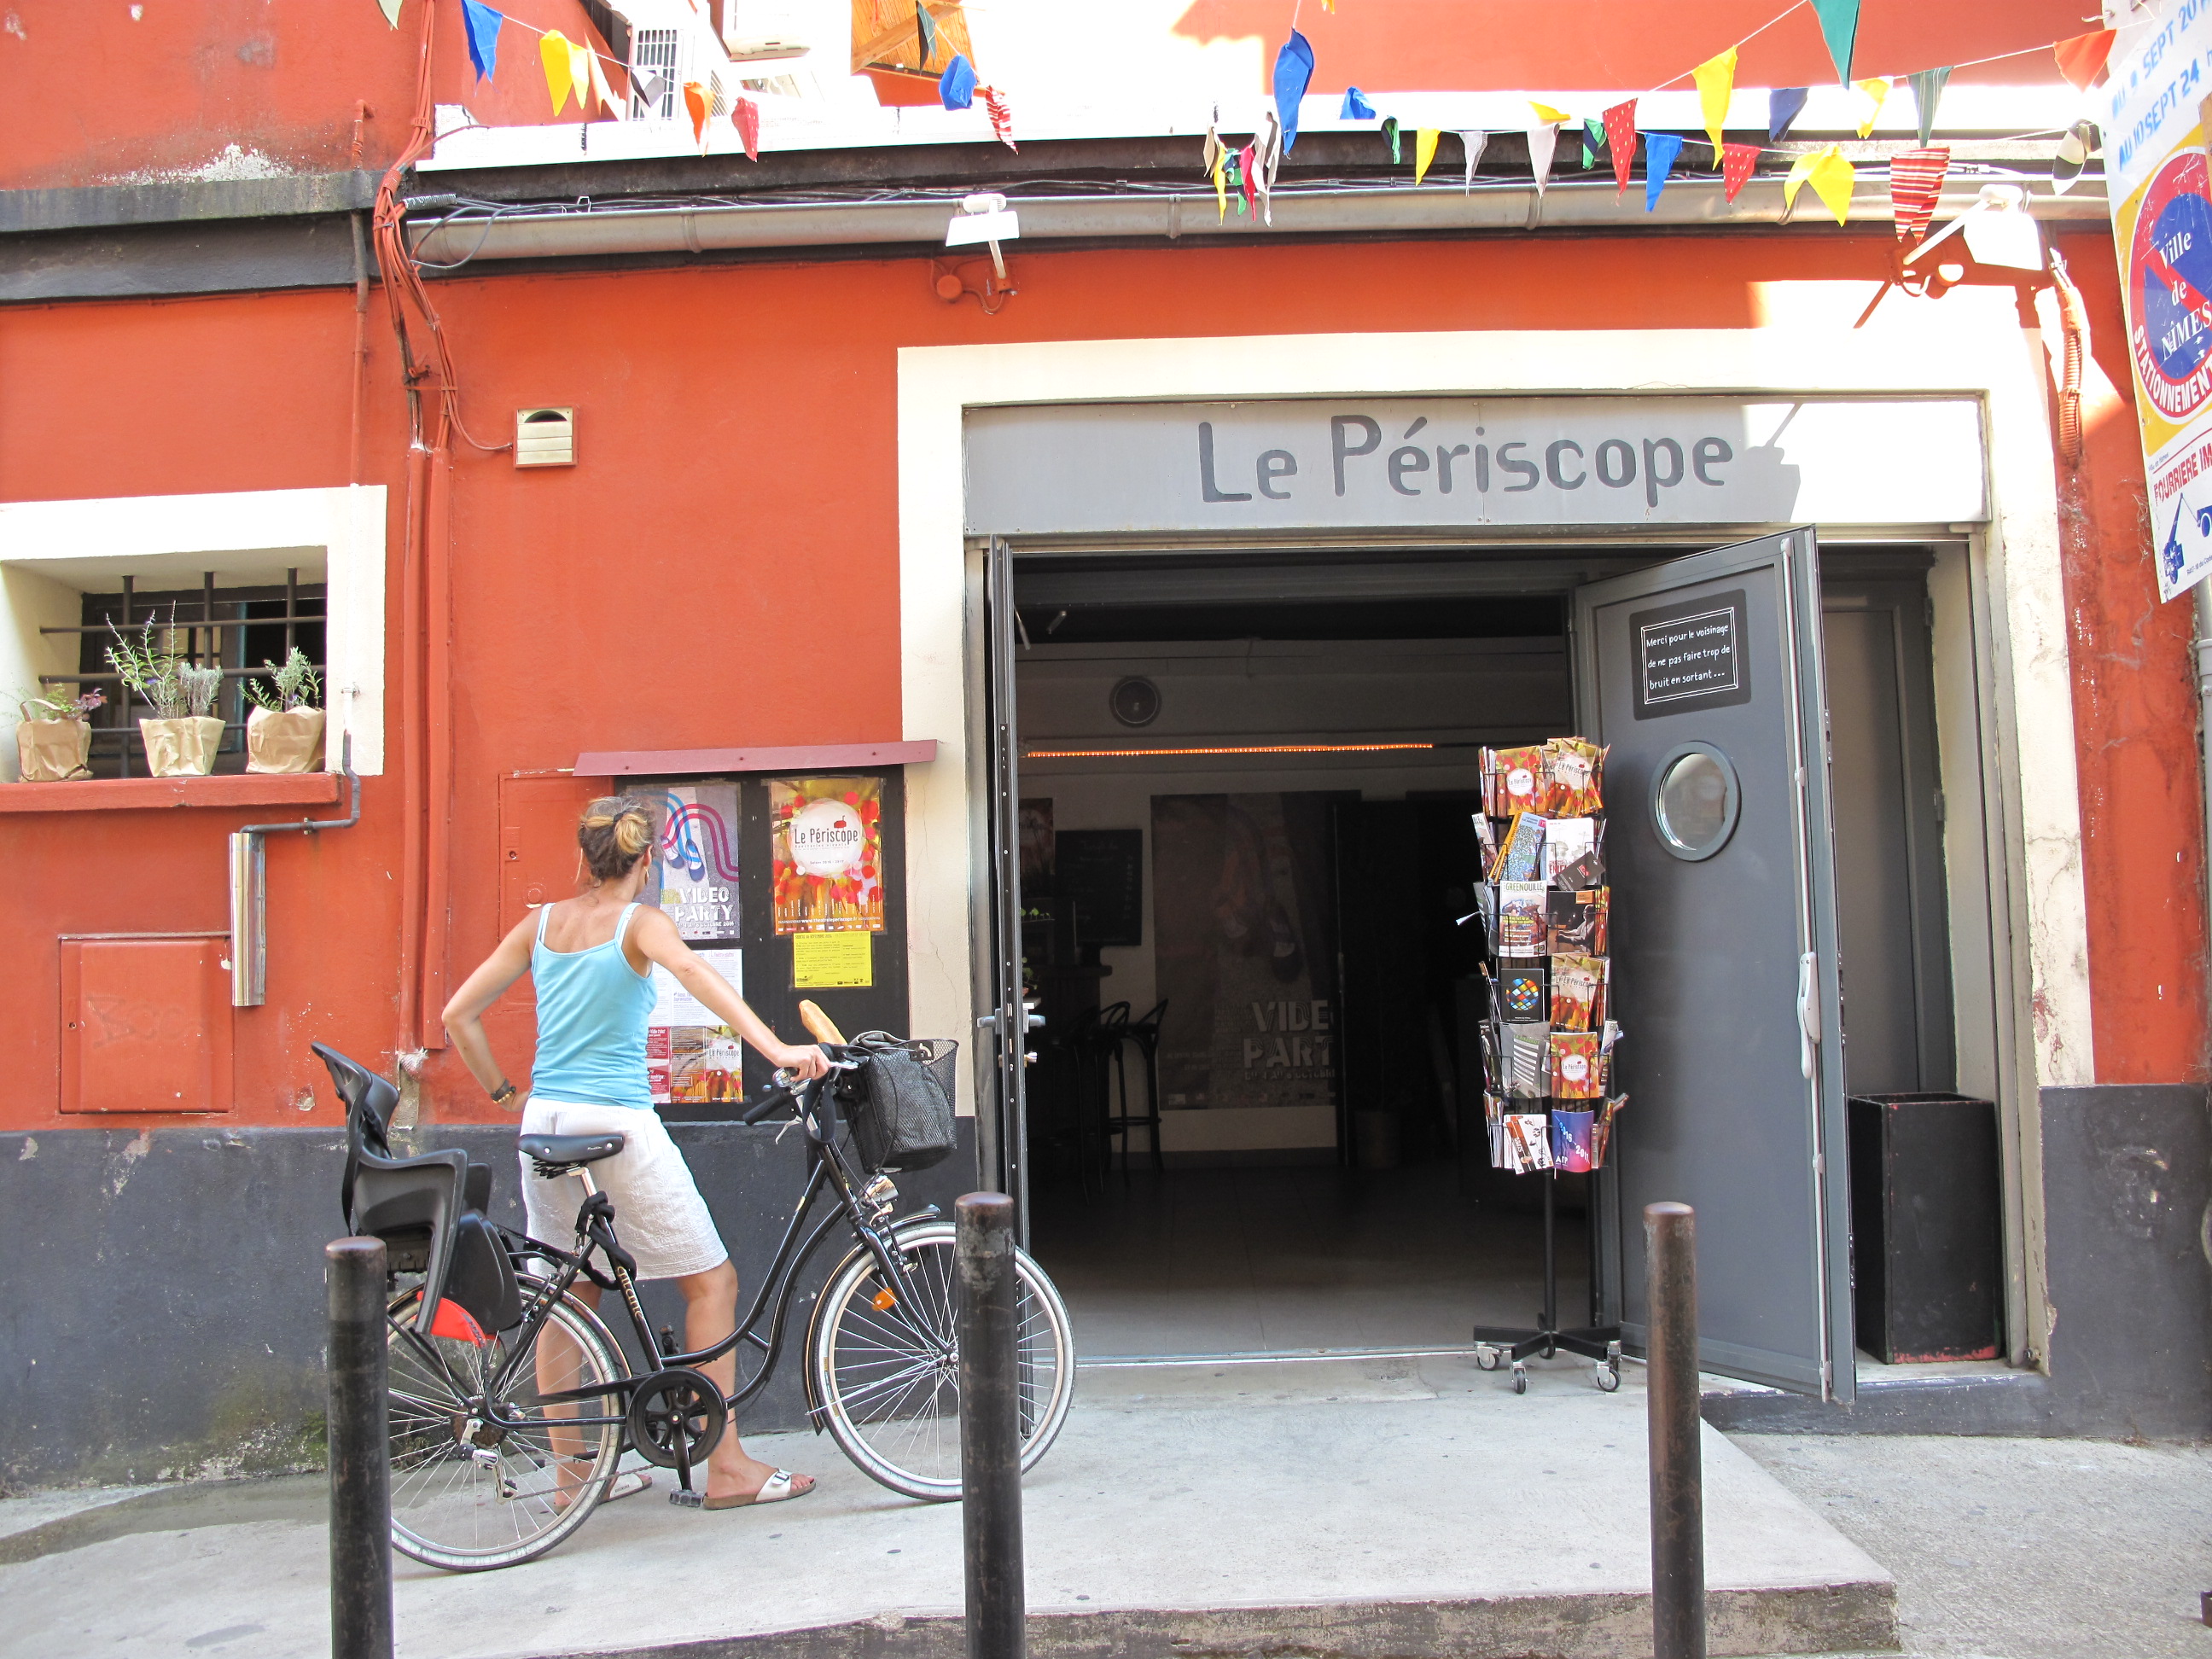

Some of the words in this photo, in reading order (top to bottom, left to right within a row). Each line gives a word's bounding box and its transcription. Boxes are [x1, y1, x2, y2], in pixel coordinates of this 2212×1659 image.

[2143, 20, 2174, 79] SEPT
[2145, 81, 2178, 139] SEPT
[2180, 57, 2200, 99] 24
[2159, 231, 2193, 270] Ville
[2171, 280, 2188, 306] de
[1198, 422, 1297, 503] Le
[1331, 415, 1733, 507] Périscope
[1646, 635, 1668, 648] Merci
[1668, 633, 1687, 646] pour
[1688, 630, 1694, 639] le
[1696, 625, 1729, 637] voisinage
[1648, 659, 1656, 668] de
[1657, 658, 1666, 667] ne
[1668, 656, 1682, 667] pas
[1683, 652, 1702, 662] faire
[1703, 648, 1720, 661] trop
[1720, 644, 1731, 655] de
[1650, 678, 1670, 690] bruit
[1670, 676, 1680, 684] en
[795, 828, 806, 844] Le
[810, 827, 859, 845] Périscope
[678, 886, 730, 903] VIDEO
[1505, 882, 1542, 892] GREENOUILLE
[674, 905, 734, 922] PARTY
[1252, 1000, 1334, 1033] VIDE
[1243, 1035, 1335, 1068] PART
[1559, 1121, 1573, 1143] 2016
